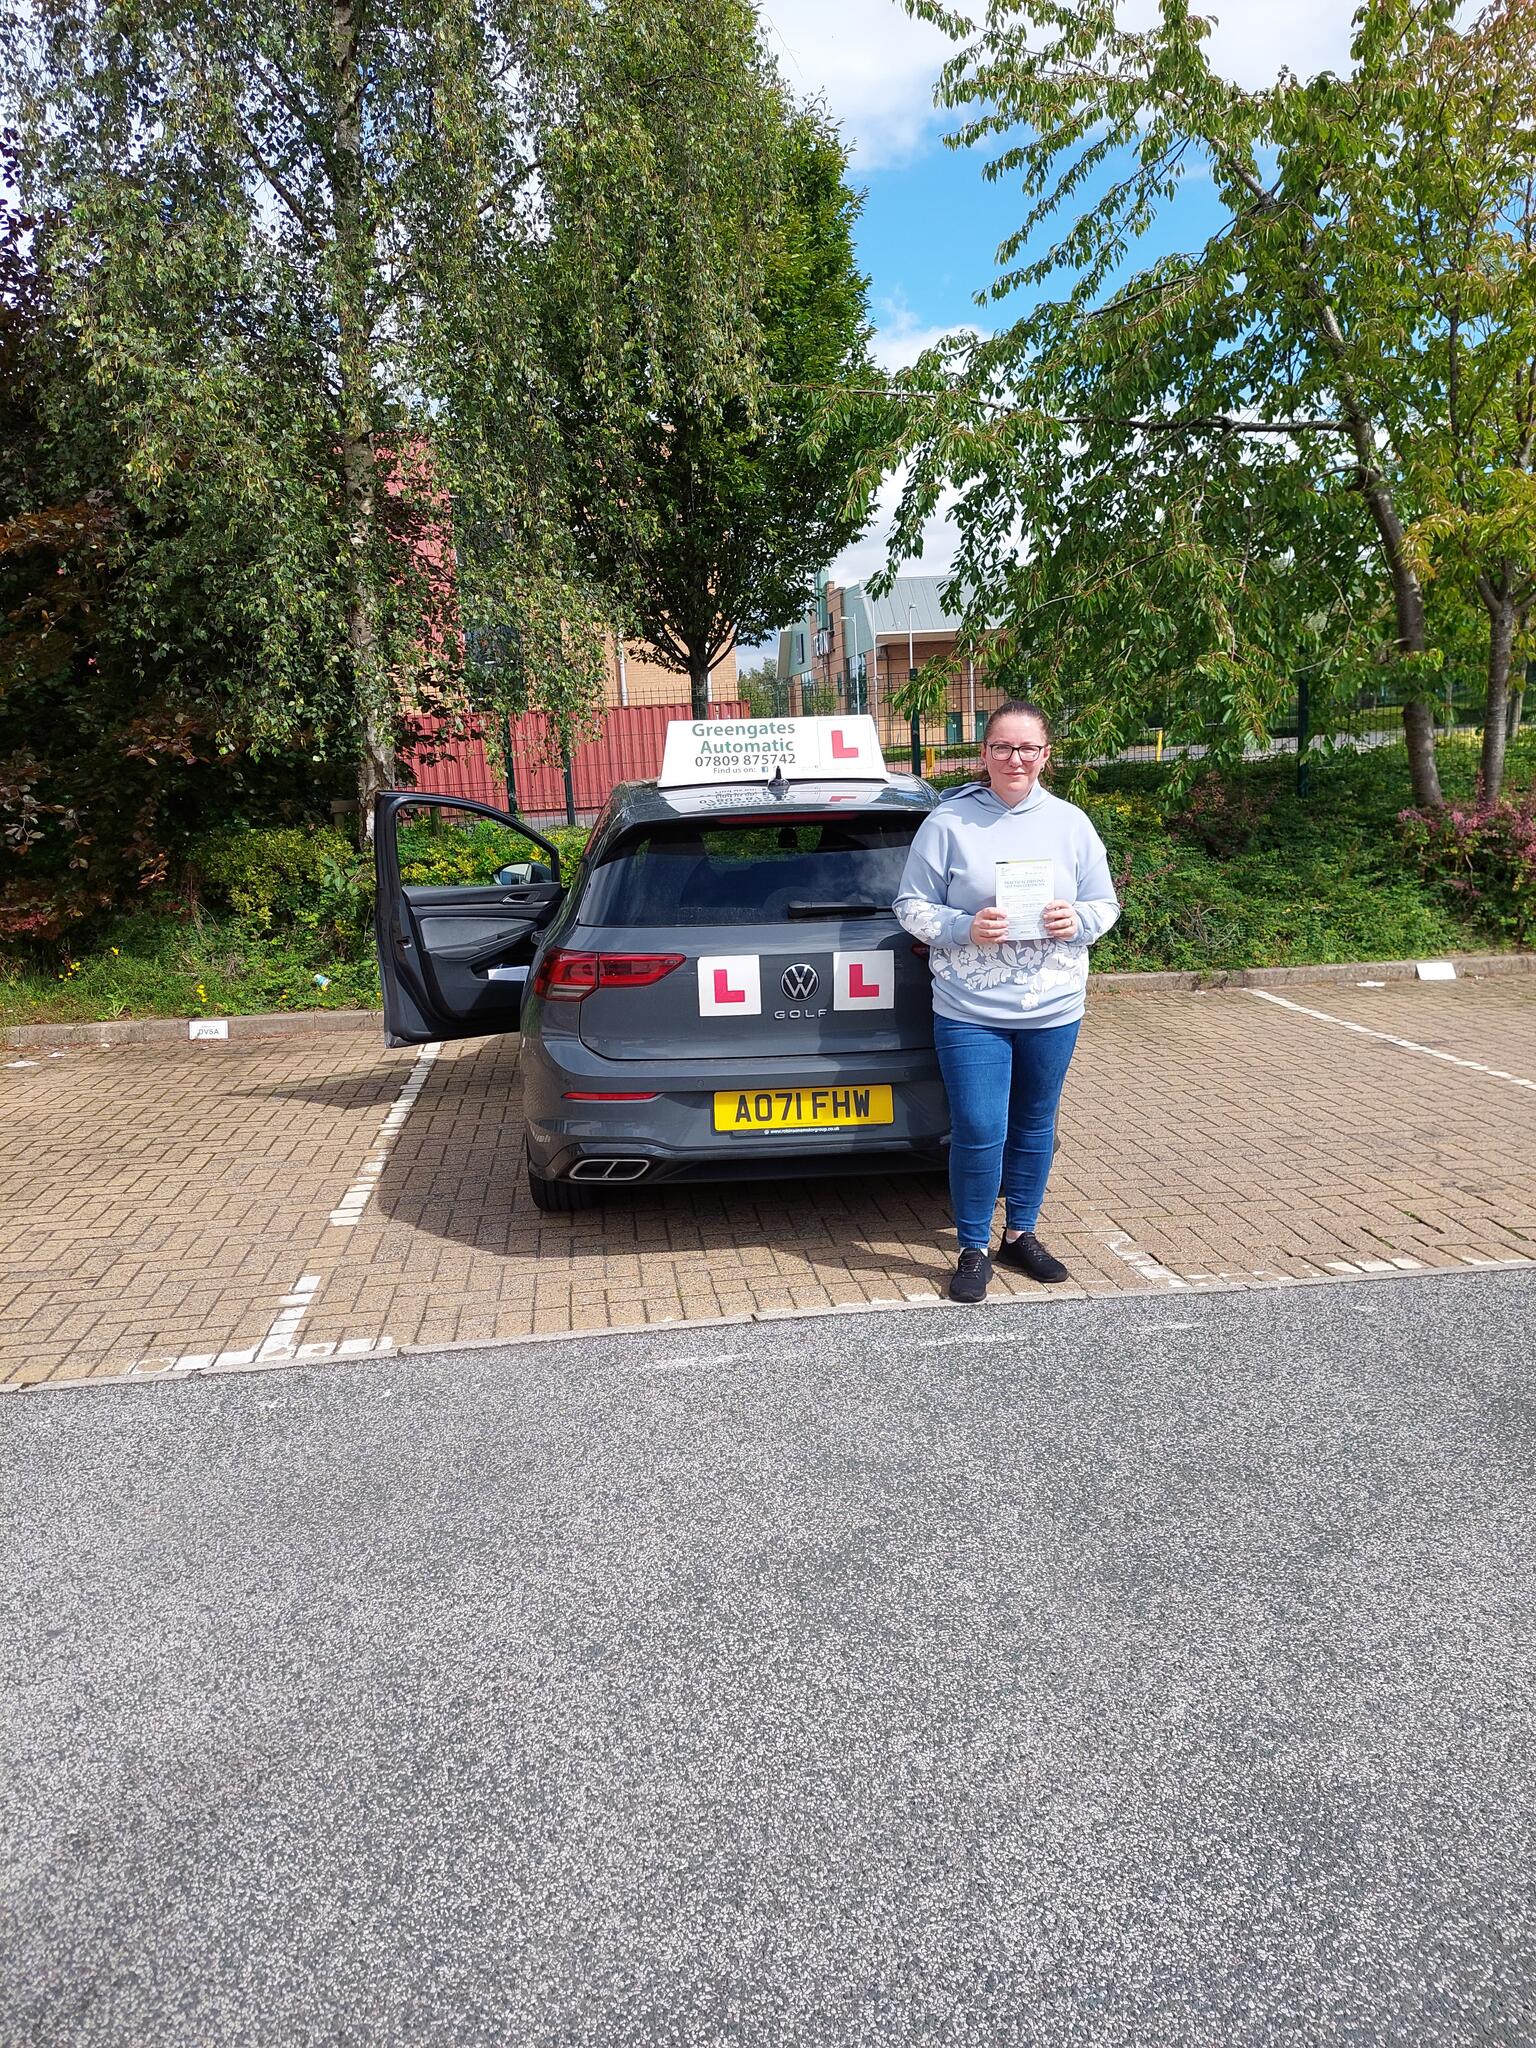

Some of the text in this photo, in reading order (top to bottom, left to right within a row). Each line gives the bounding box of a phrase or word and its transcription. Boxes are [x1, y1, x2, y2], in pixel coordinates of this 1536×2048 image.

[692, 722, 795, 738] Greengates
[700, 738, 794, 754] Automatic
[831, 730, 859, 759] L
[695, 753, 796, 767] 07809 875742
[713, 969, 745, 1003] L
[849, 963, 880, 998] L
[774, 1008, 828, 1019] GOLF
[812, 1089, 870, 1120] FHW
